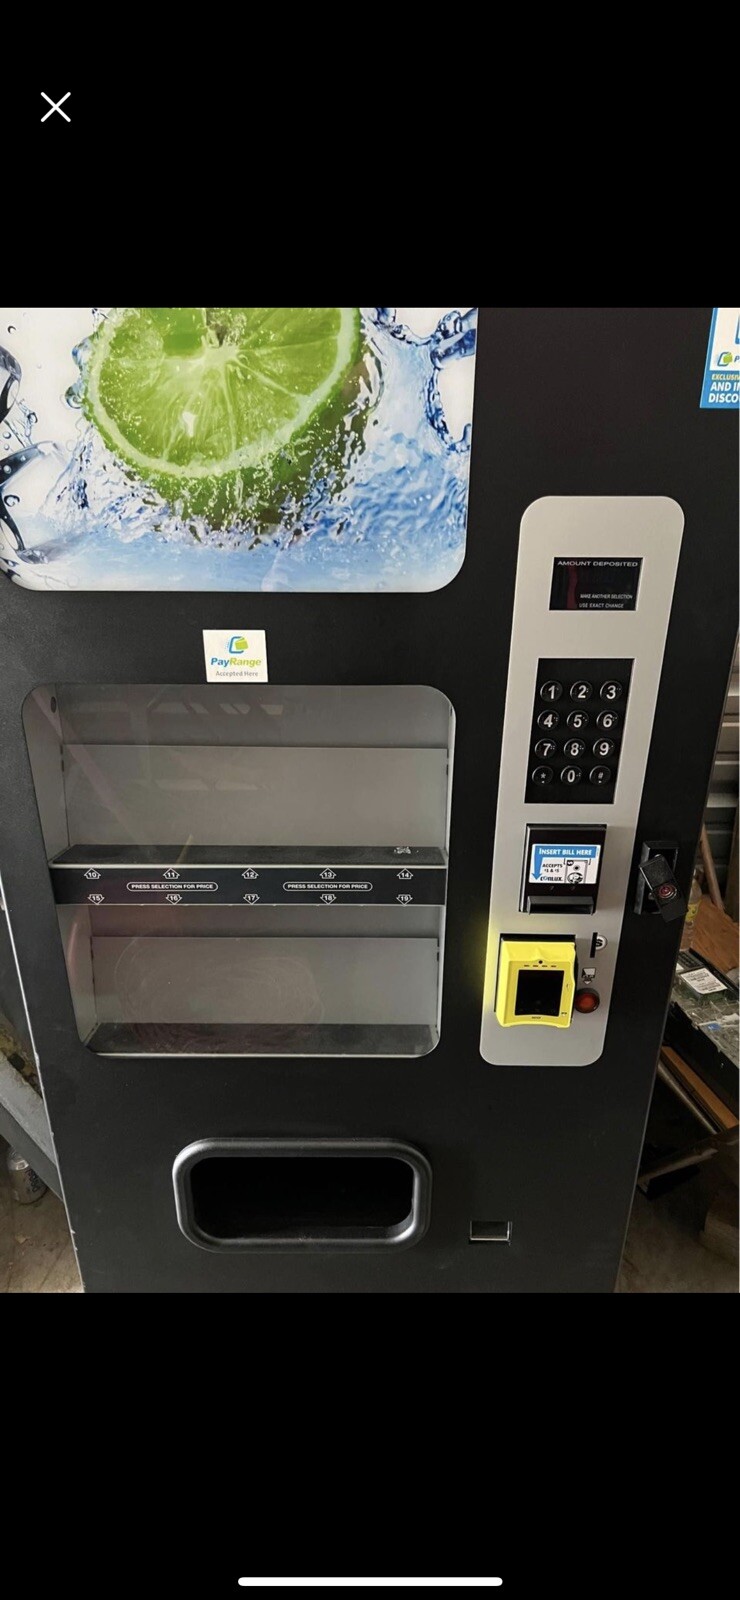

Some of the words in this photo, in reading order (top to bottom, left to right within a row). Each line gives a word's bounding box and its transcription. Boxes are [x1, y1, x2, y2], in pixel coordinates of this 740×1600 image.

[710, 381, 732, 391] AND
[708, 393, 739, 403] DISCO
[210, 658, 261, 667] PayRange
[548, 685, 556, 700] 1
[577, 685, 587, 699] 2
[606, 685, 617, 700] 3
[543, 714, 553, 728] 4
[573, 714, 582, 728] 5
[602, 714, 613, 728] 6
[543, 743, 552, 757] 7
[570, 742, 579, 756] 8
[599, 742, 609, 756] 9
[567, 769, 576, 783] 0
